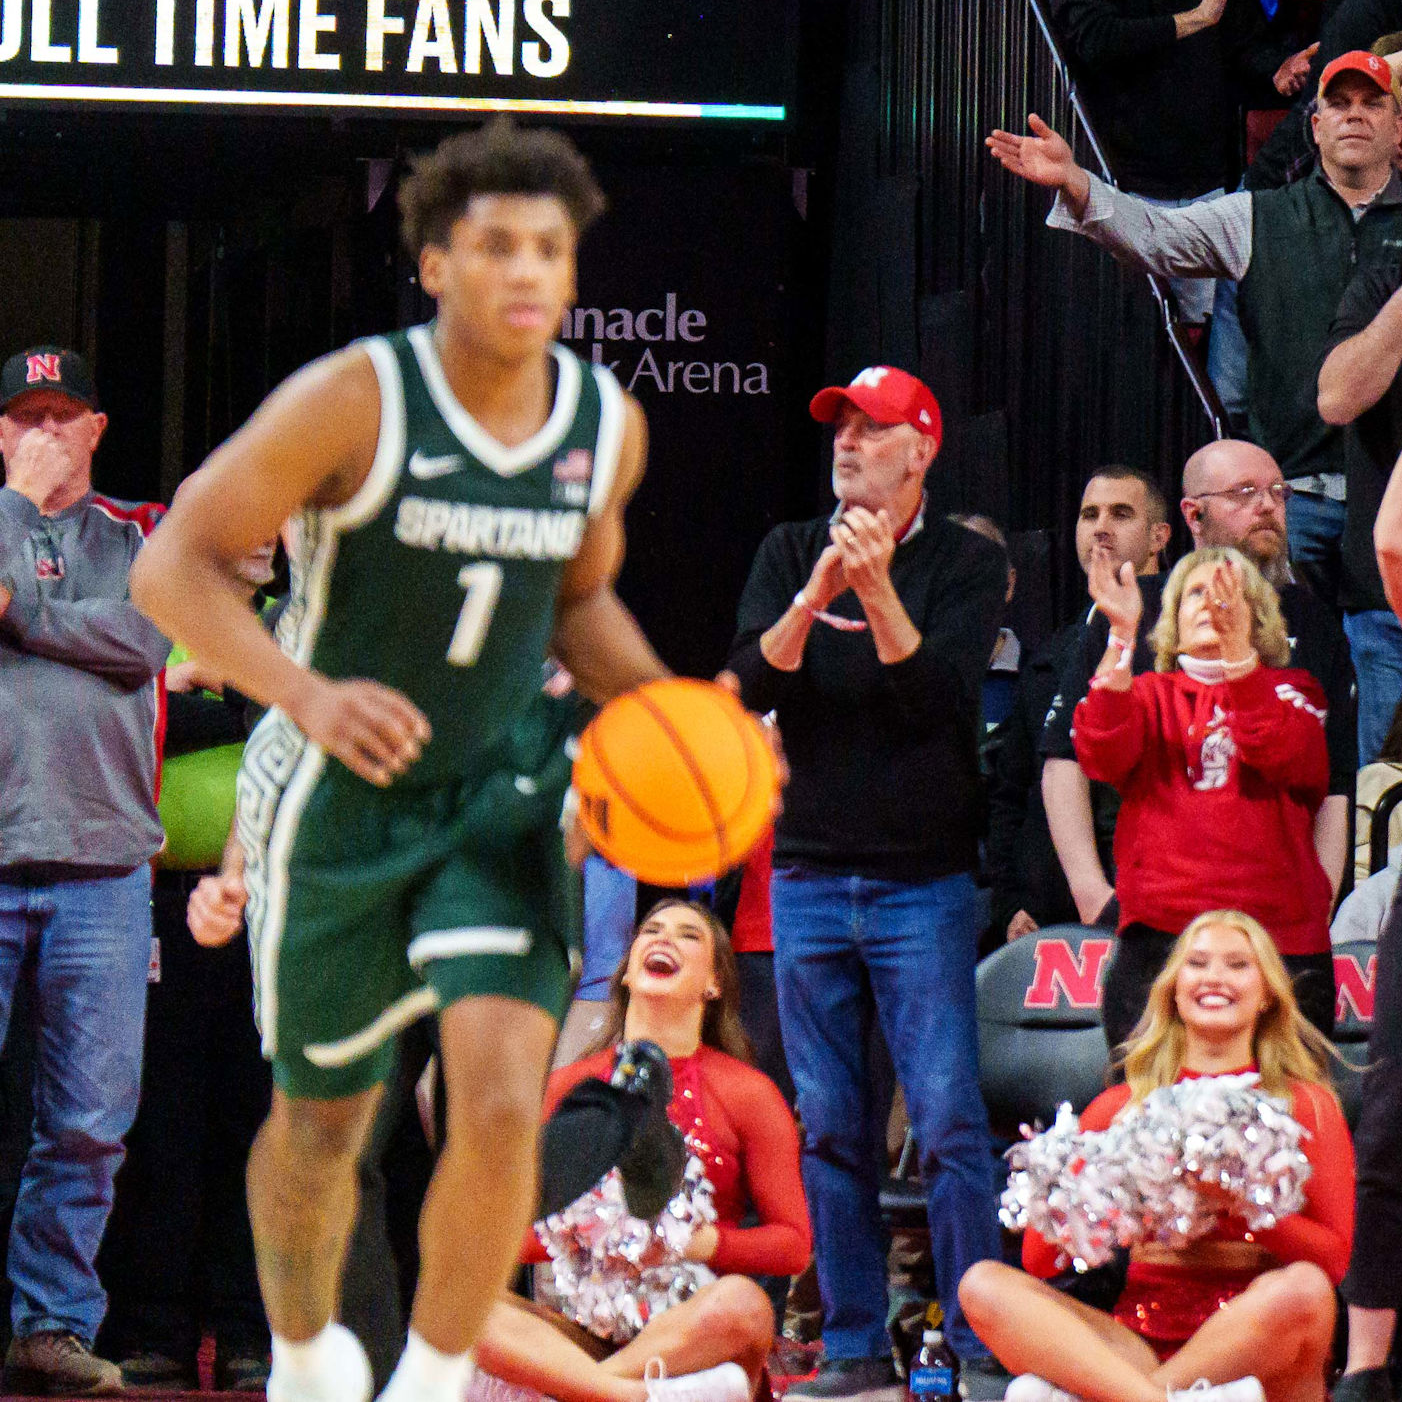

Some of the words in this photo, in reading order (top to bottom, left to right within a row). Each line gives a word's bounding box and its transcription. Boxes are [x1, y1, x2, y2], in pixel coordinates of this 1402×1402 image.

[561, 292, 708, 343] nacle
[25, 353, 62, 385] N
[626, 350, 771, 396] Arena
[395, 495, 587, 560] SPARTANS
[446, 561, 503, 668] 1
[1024, 938, 1113, 1010] N
[1330, 952, 1378, 1024] N
